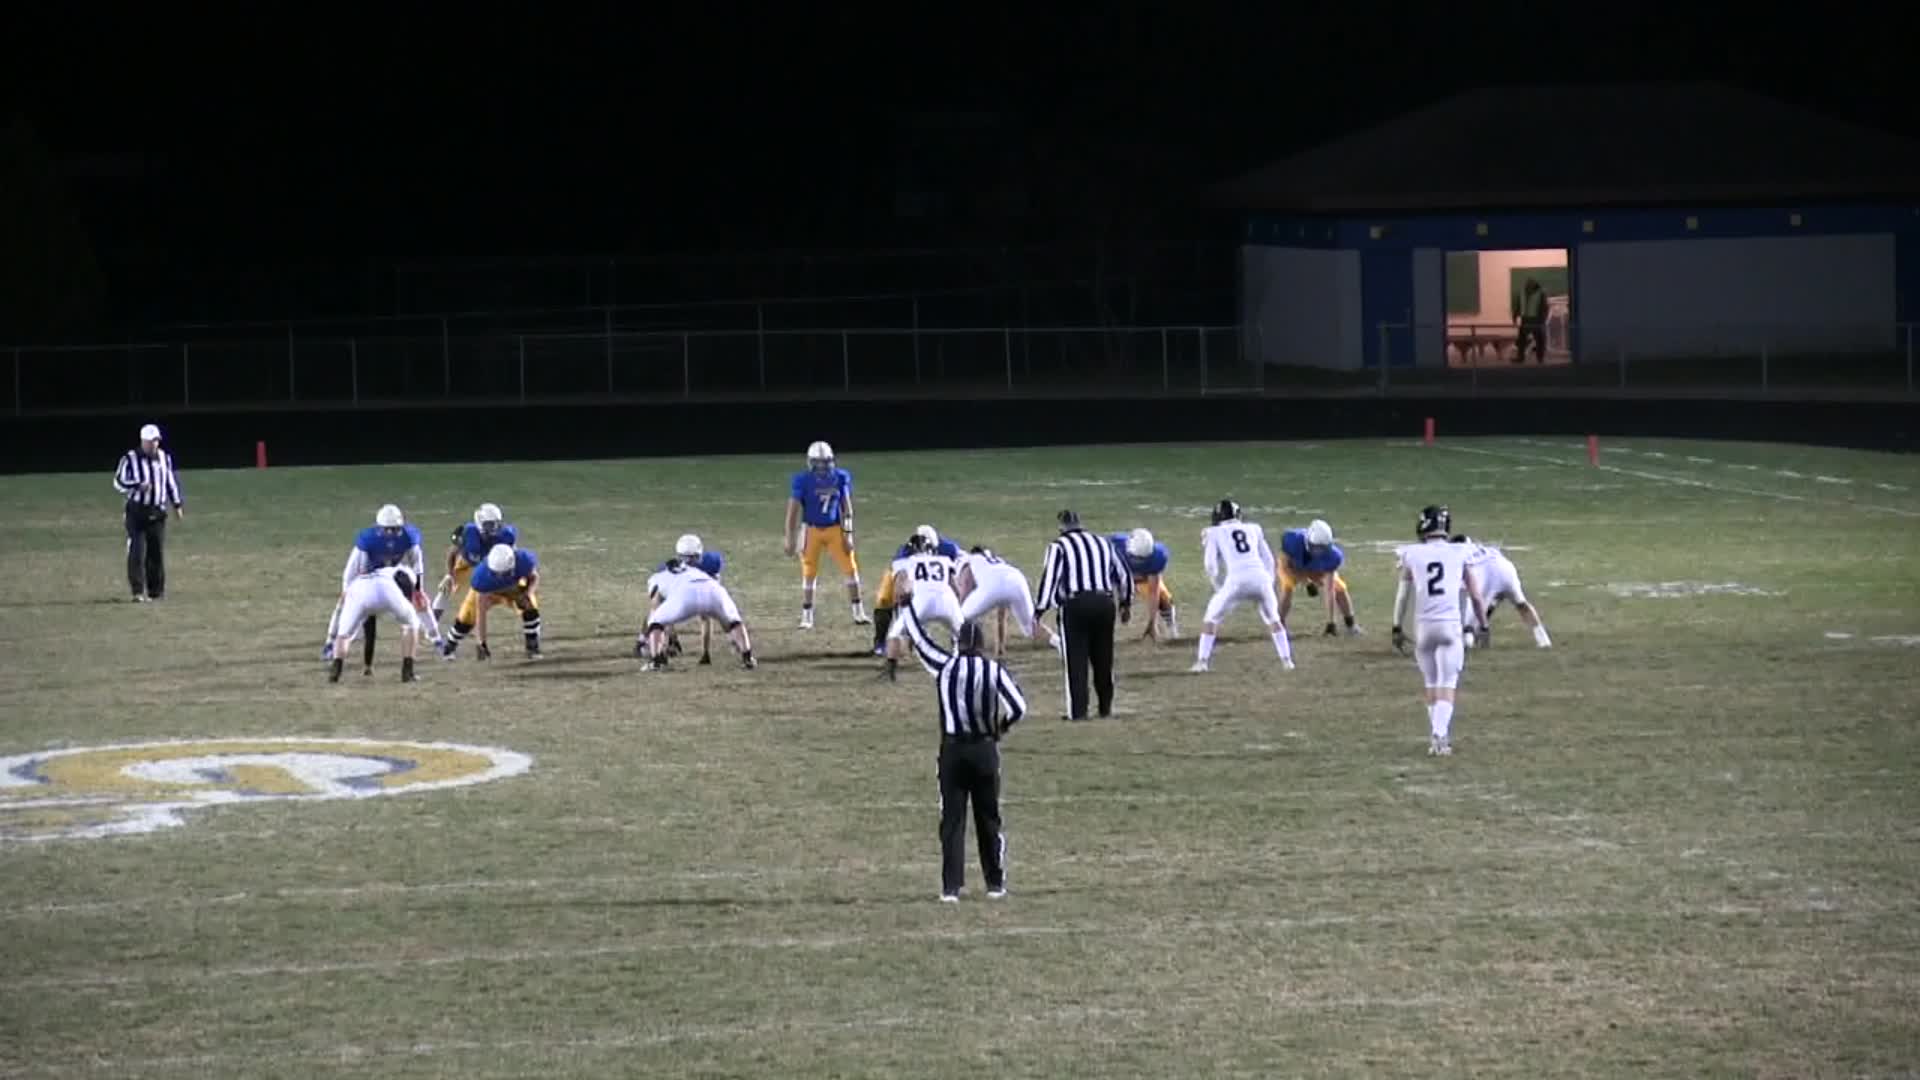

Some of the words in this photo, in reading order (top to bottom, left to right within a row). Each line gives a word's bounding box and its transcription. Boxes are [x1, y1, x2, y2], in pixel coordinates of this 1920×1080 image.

[1231, 529, 1251, 554] 8
[914, 561, 946, 582] 43
[1426, 562, 1446, 597] 2
